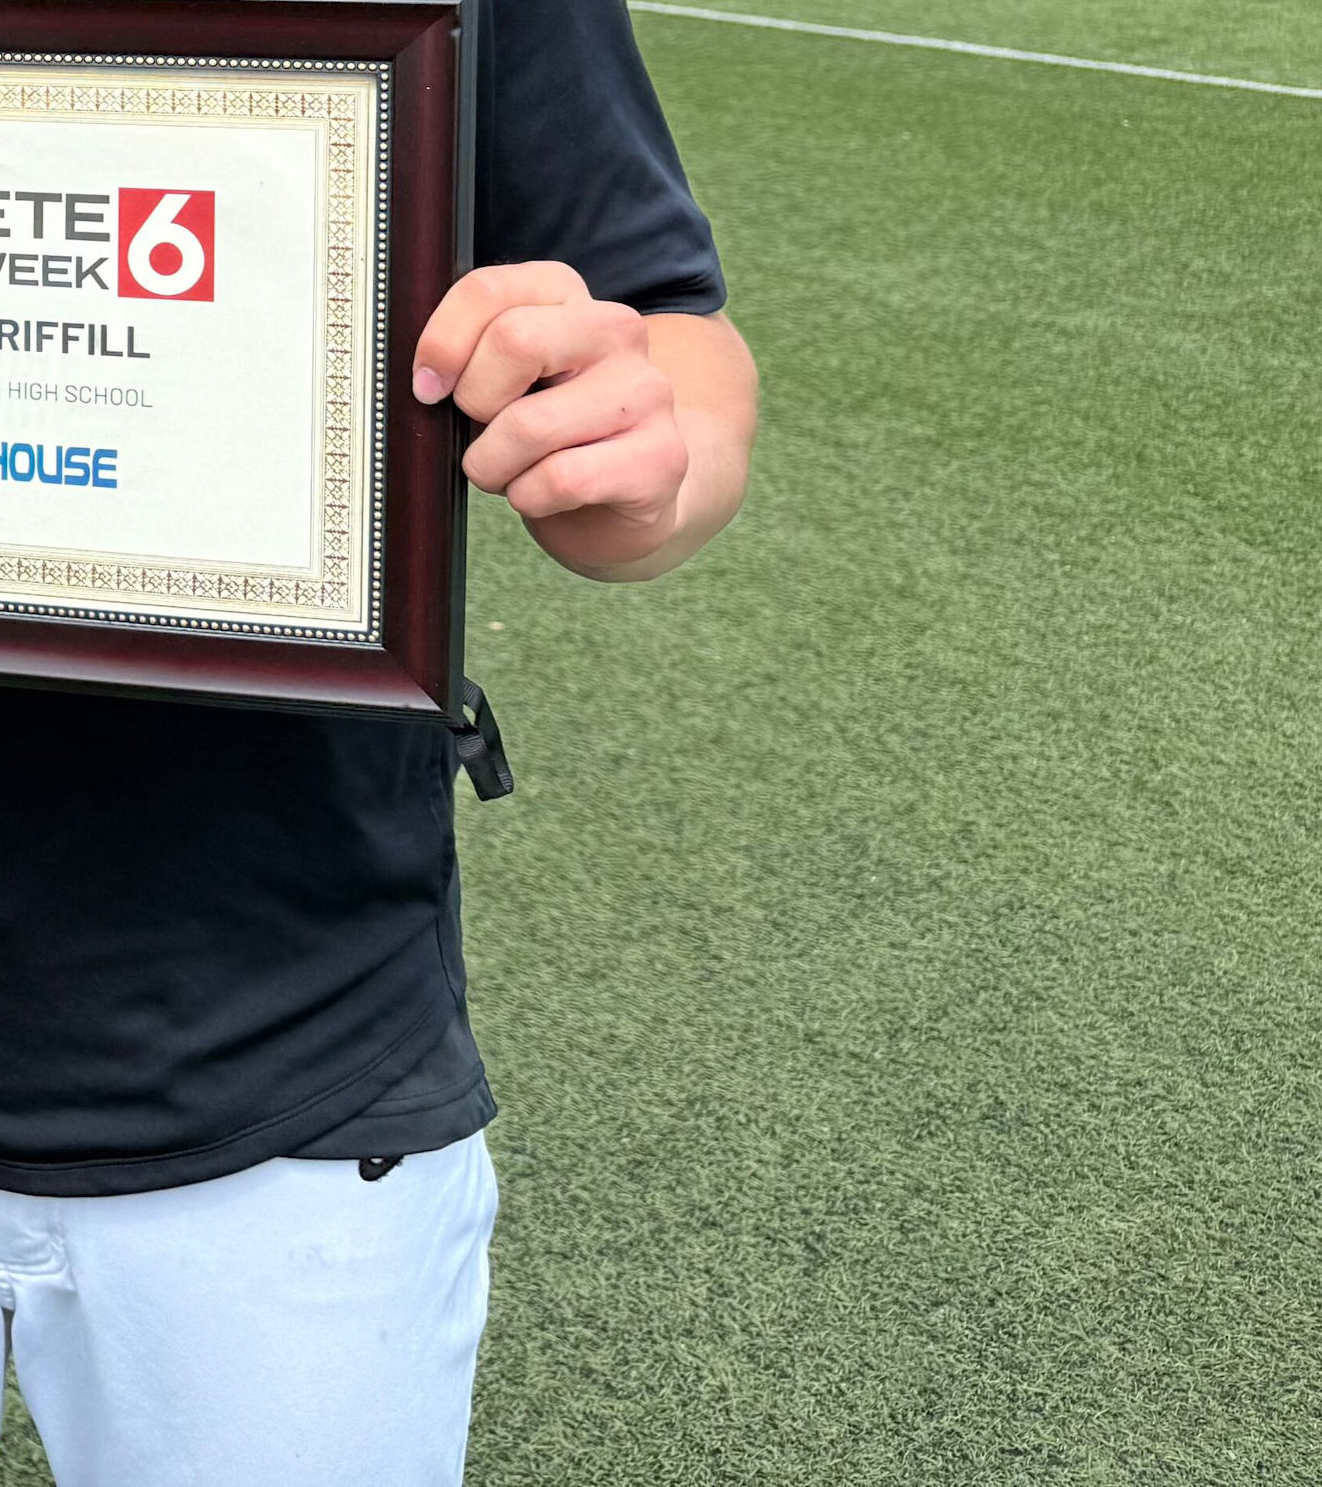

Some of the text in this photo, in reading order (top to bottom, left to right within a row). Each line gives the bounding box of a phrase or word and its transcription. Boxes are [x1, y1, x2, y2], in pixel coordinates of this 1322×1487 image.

[126, 193, 205, 297] 6
[7, 379, 60, 402] HIGH
[64, 383, 154, 408] SCHOOL
